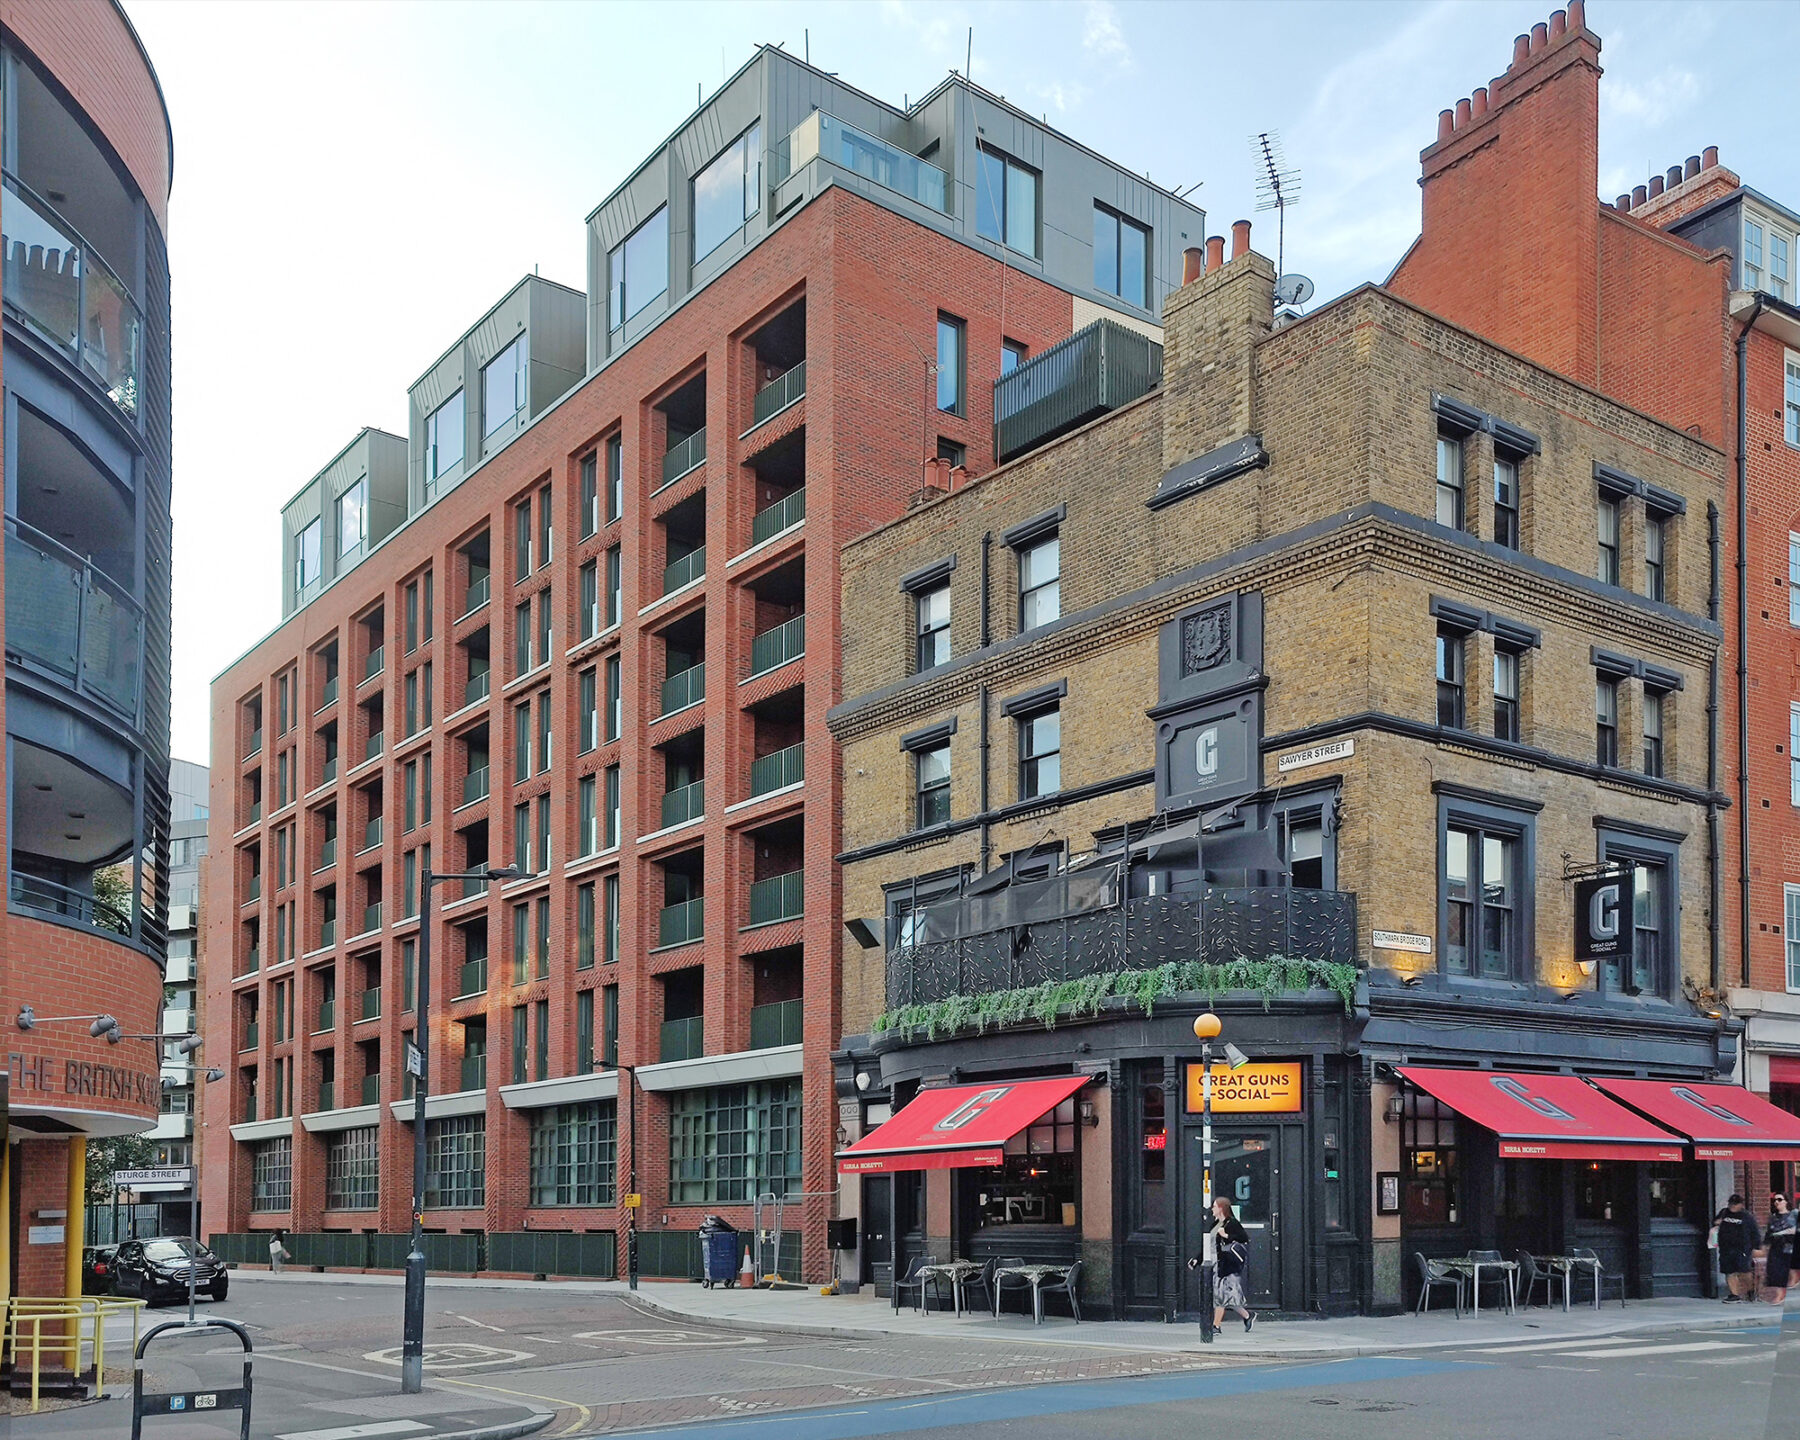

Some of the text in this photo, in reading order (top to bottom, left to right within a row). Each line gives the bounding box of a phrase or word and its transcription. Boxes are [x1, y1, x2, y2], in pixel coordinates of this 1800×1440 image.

[1196, 727, 1217, 775] G
[1280, 743, 1346, 766] SAWYER STREET
[1589, 884, 1619, 941] G
[66, 1060, 133, 1101] BRITISH
[1198, 1075, 1290, 1086] GREAT GUNS
[1217, 1088, 1271, 1100] SOCIAL
[116, 1170, 182, 1179] STURGE STREET
[1235, 1175, 1250, 1200] G
[174, 1398, 183, 1408] P
